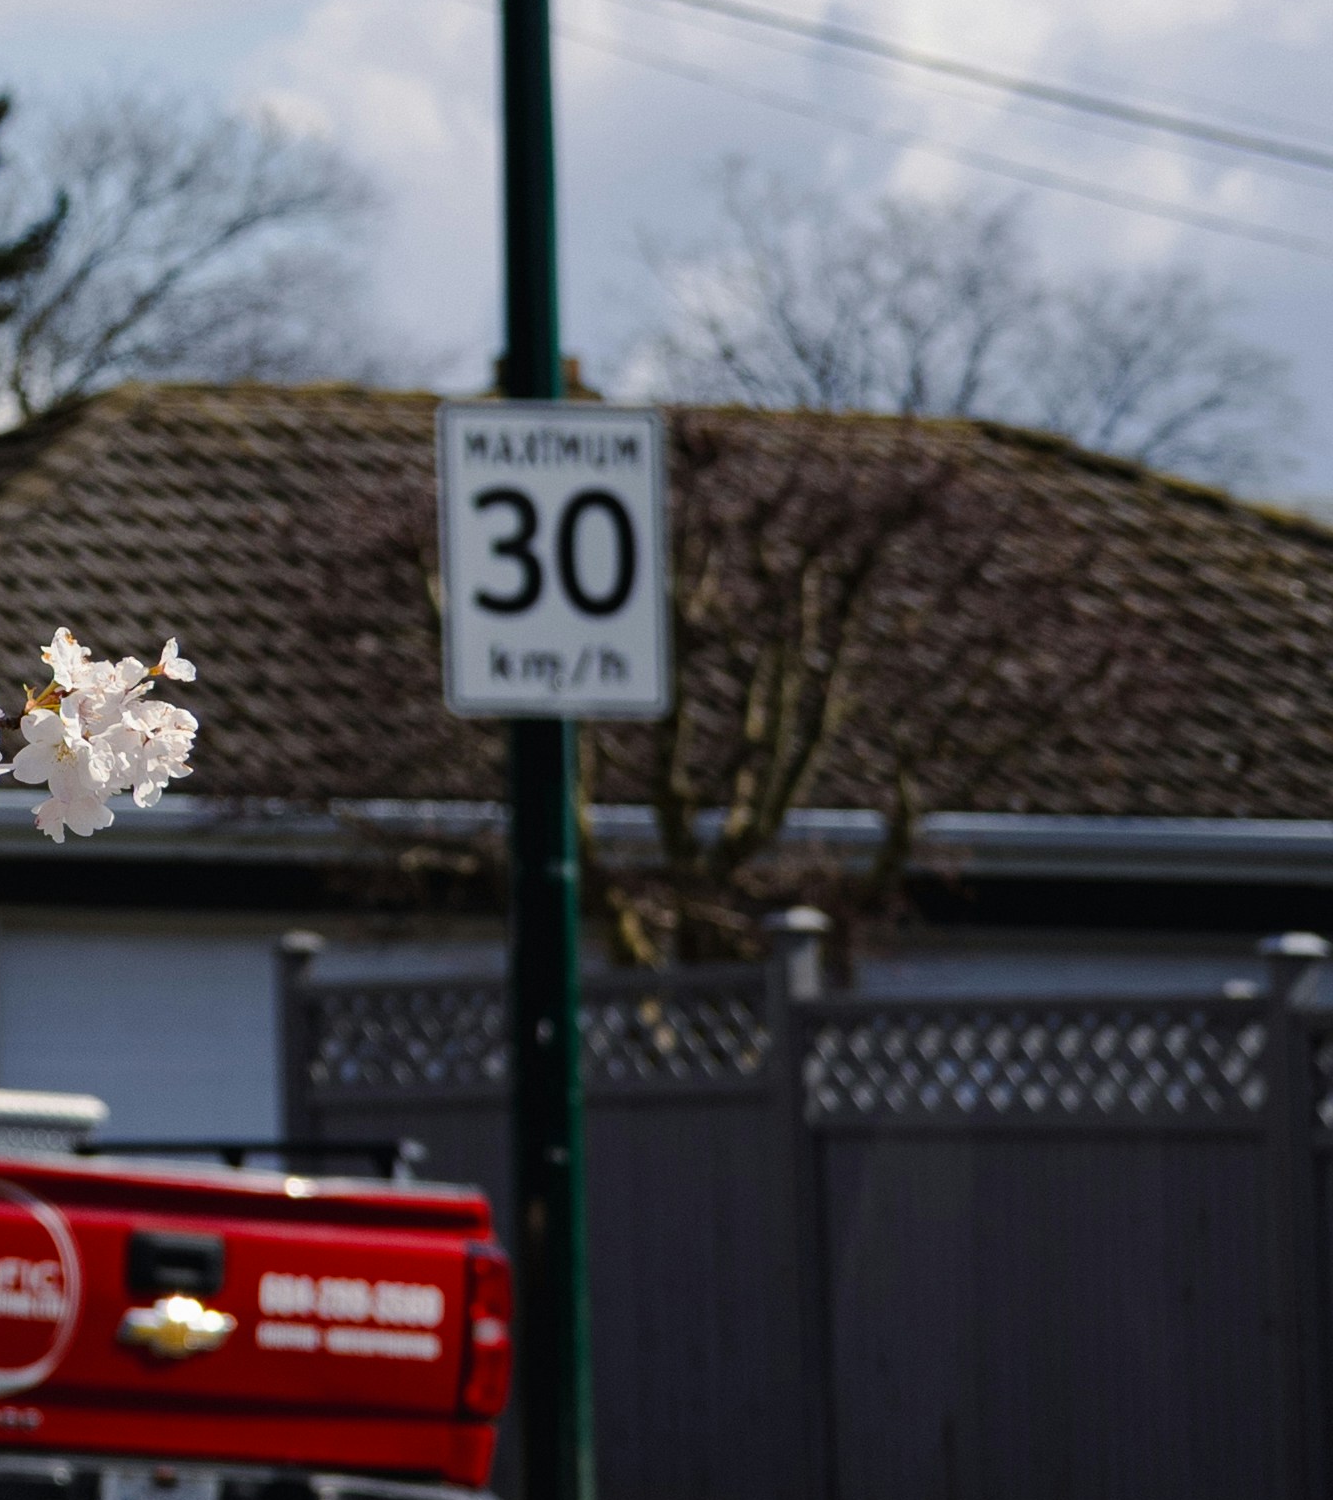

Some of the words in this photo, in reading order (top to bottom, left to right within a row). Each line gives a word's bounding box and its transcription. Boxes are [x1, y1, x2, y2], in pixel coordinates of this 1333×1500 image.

[464, 430, 641, 469] MAXIMUM
[473, 486, 637, 619] 30
[489, 644, 627, 685] km/h
